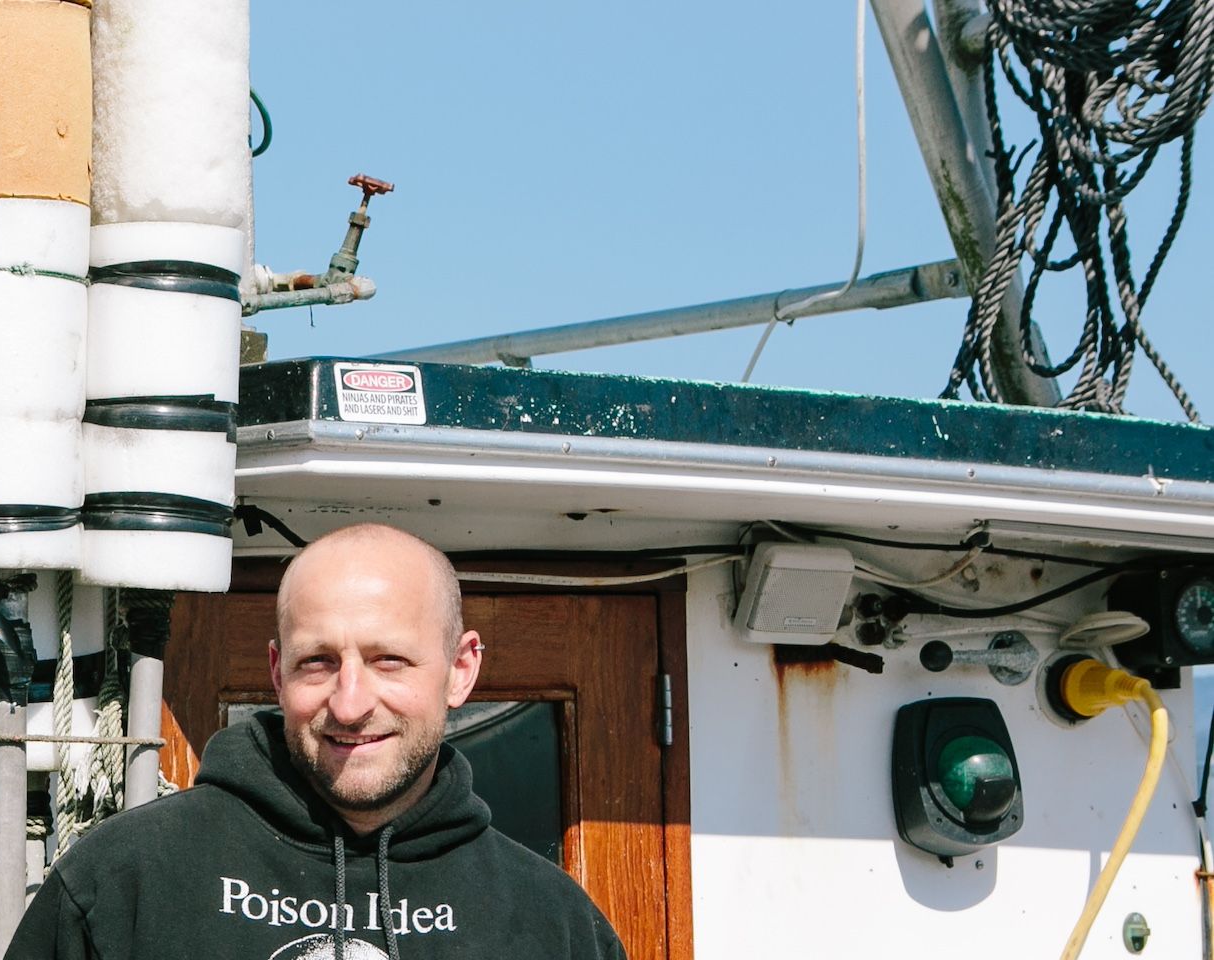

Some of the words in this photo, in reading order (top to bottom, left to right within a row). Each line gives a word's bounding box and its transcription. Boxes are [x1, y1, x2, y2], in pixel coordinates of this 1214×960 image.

[350, 374, 406, 388] DANGER
[342, 393, 369, 402] NINJAS
[370, 394, 387, 404] AND
[388, 395, 418, 405] PIRATES
[344, 404, 360, 414] AND
[360, 405, 386, 415] LASERS
[387, 406, 402, 416] AND
[403, 407, 418, 416] SHIT
[219, 877, 355, 931] Poison
[365, 892, 457, 935] Idea
